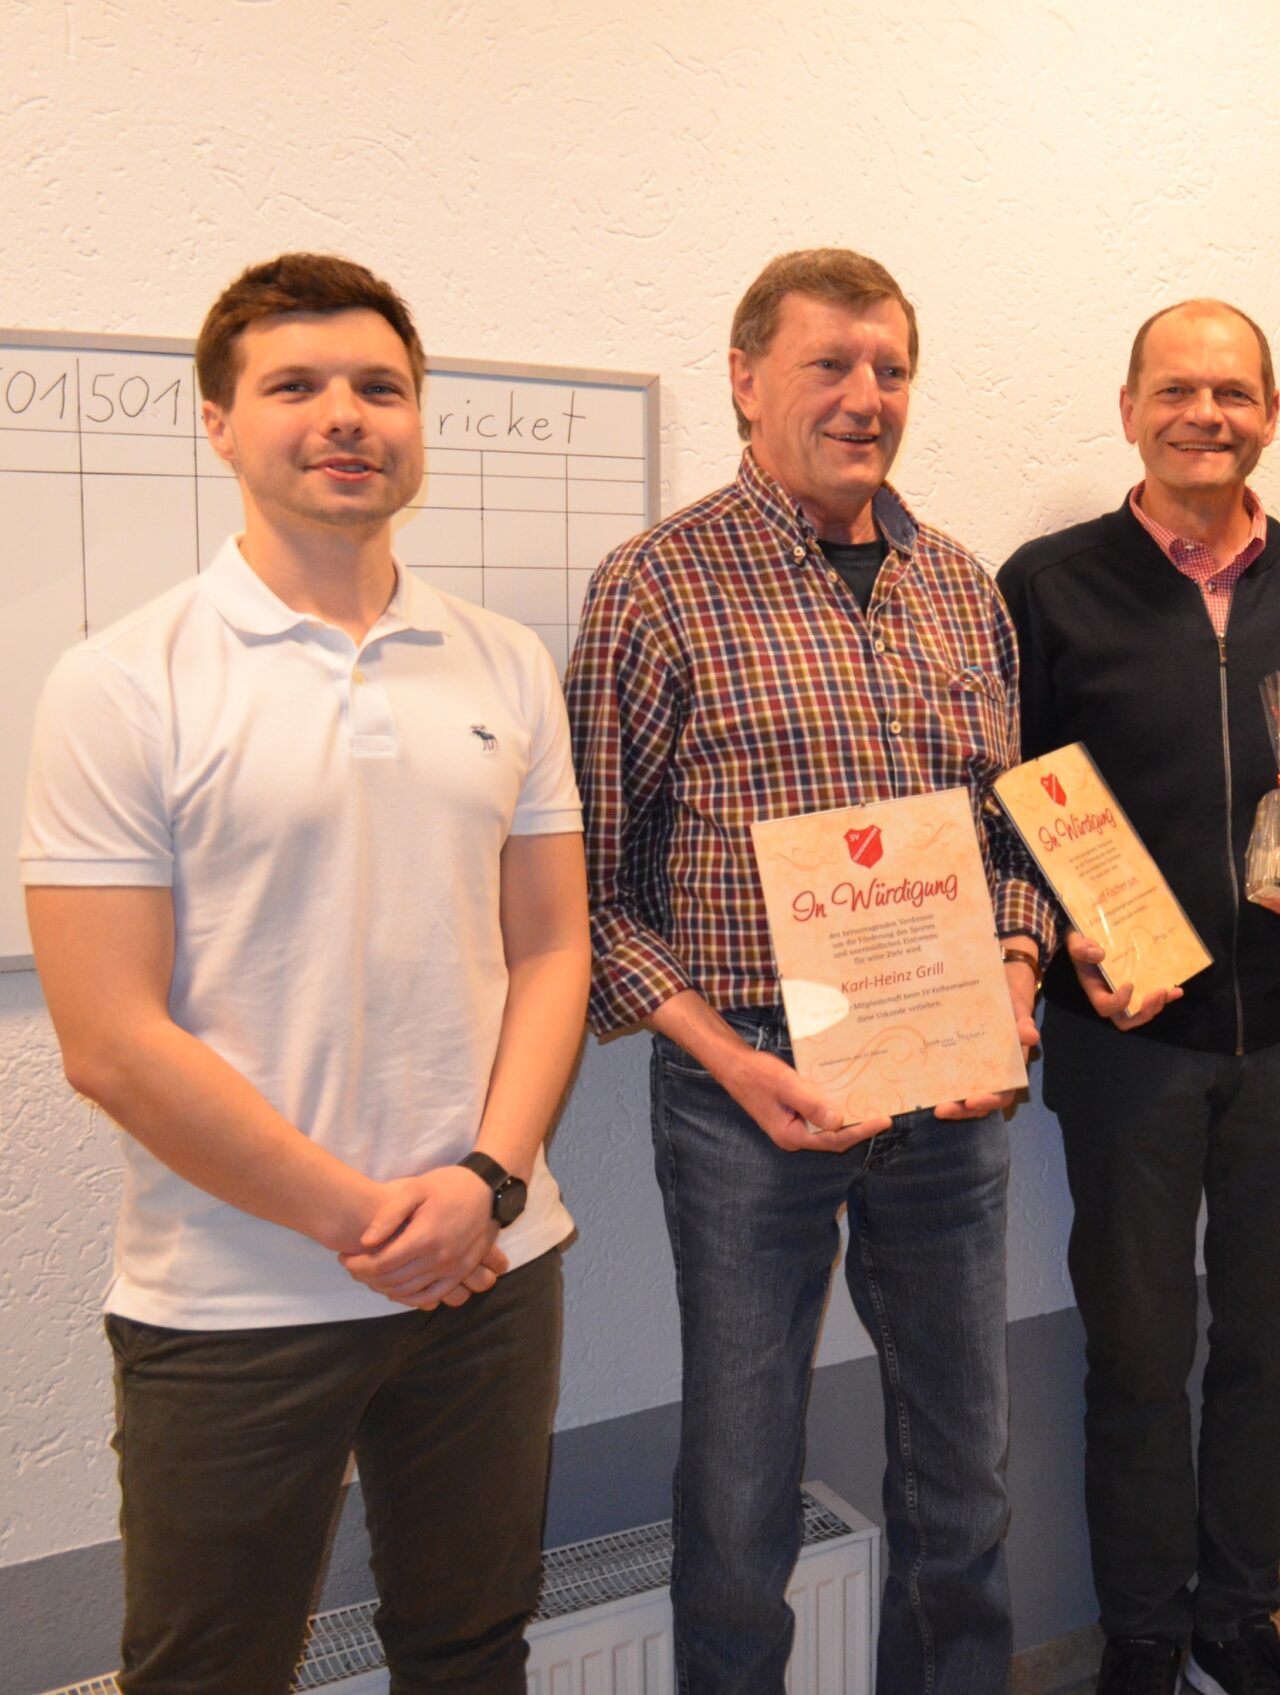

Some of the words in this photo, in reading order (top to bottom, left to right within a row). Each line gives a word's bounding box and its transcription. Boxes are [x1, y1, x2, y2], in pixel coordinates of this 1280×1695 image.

[0, 366, 67, 419] 01
[86, 373, 181, 426] 501
[437, 390, 587, 444] ricket
[792, 890, 827, 922] In
[831, 874, 957, 912] Würdigung
[841, 970, 912, 994] Karl-Heinz
[916, 961, 944, 979] Grill
